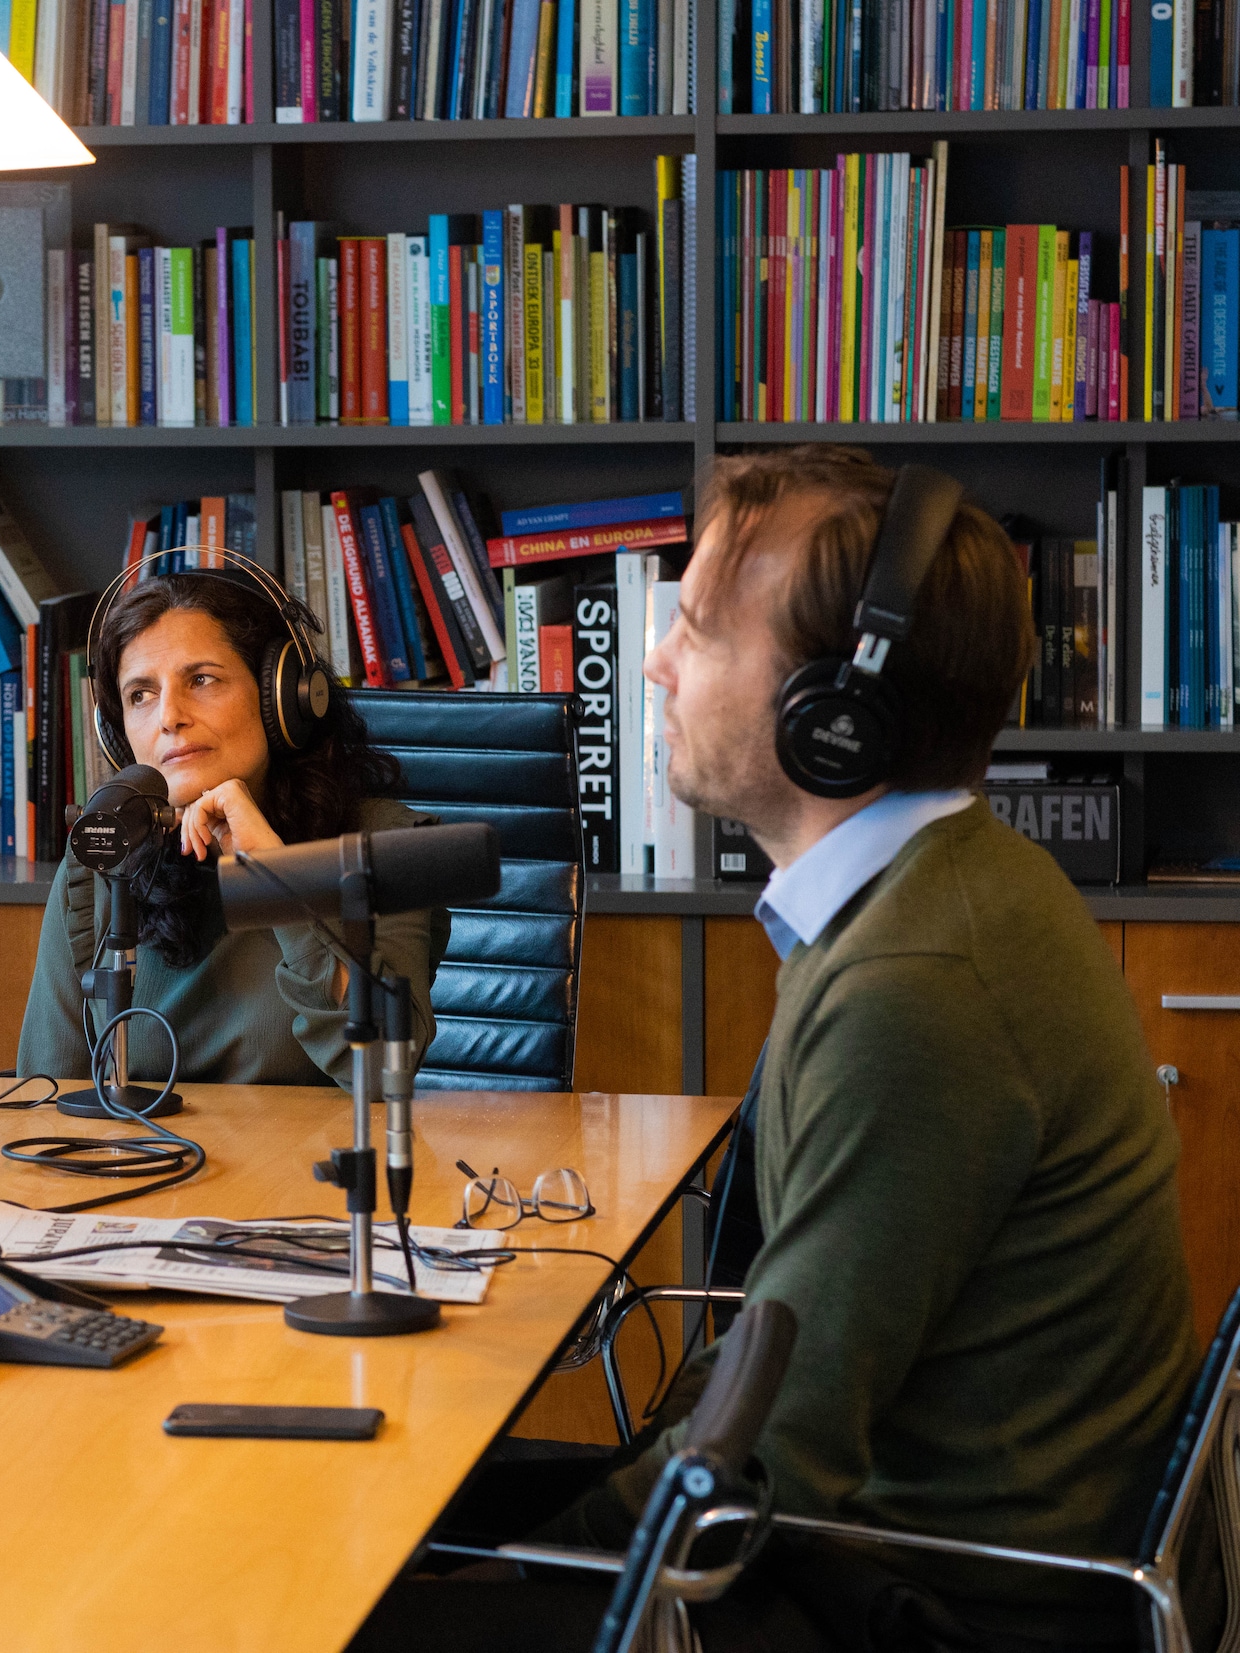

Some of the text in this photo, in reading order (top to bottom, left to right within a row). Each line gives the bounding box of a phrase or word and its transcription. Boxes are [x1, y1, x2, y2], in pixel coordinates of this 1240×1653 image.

[321, 32, 332, 97] VERHOEVEN
[367, 9, 377, 108] van de Volkskrant
[512, 215, 523, 270] Waldemar
[79, 263, 91, 291] WIJ
[512, 270, 523, 294] Post
[512, 294, 523, 306] de
[1214, 294, 1227, 307] DE
[79, 296, 91, 342] EISEN
[412, 286, 421, 325] BLANKEN
[527, 252, 540, 369] ONTDEK EUROPA 33
[989, 267, 1003, 393] SIGMUND FEESTDAGEN
[1183, 235, 1198, 394] THE DAILY GORILLA
[113, 323, 124, 374] SCHEIDEN
[487, 289, 500, 384] SPORTBOEK
[951, 336, 962, 386] VROUWEN
[977, 336, 988, 384] VAKANTIE
[1052, 337, 1063, 385] VAKANTIE
[1214, 308, 1227, 377] DESIGNPOLITIE
[964, 336, 975, 387] KINDEREN
[519, 527, 655, 557] CHINA EN EUROPA
[338, 514, 377, 664] DE SIGMUND ALMANAK
[1061, 626, 1073, 642] De
[2, 682, 13, 722] NOBEL
[591, 835, 600, 864] MENDO
